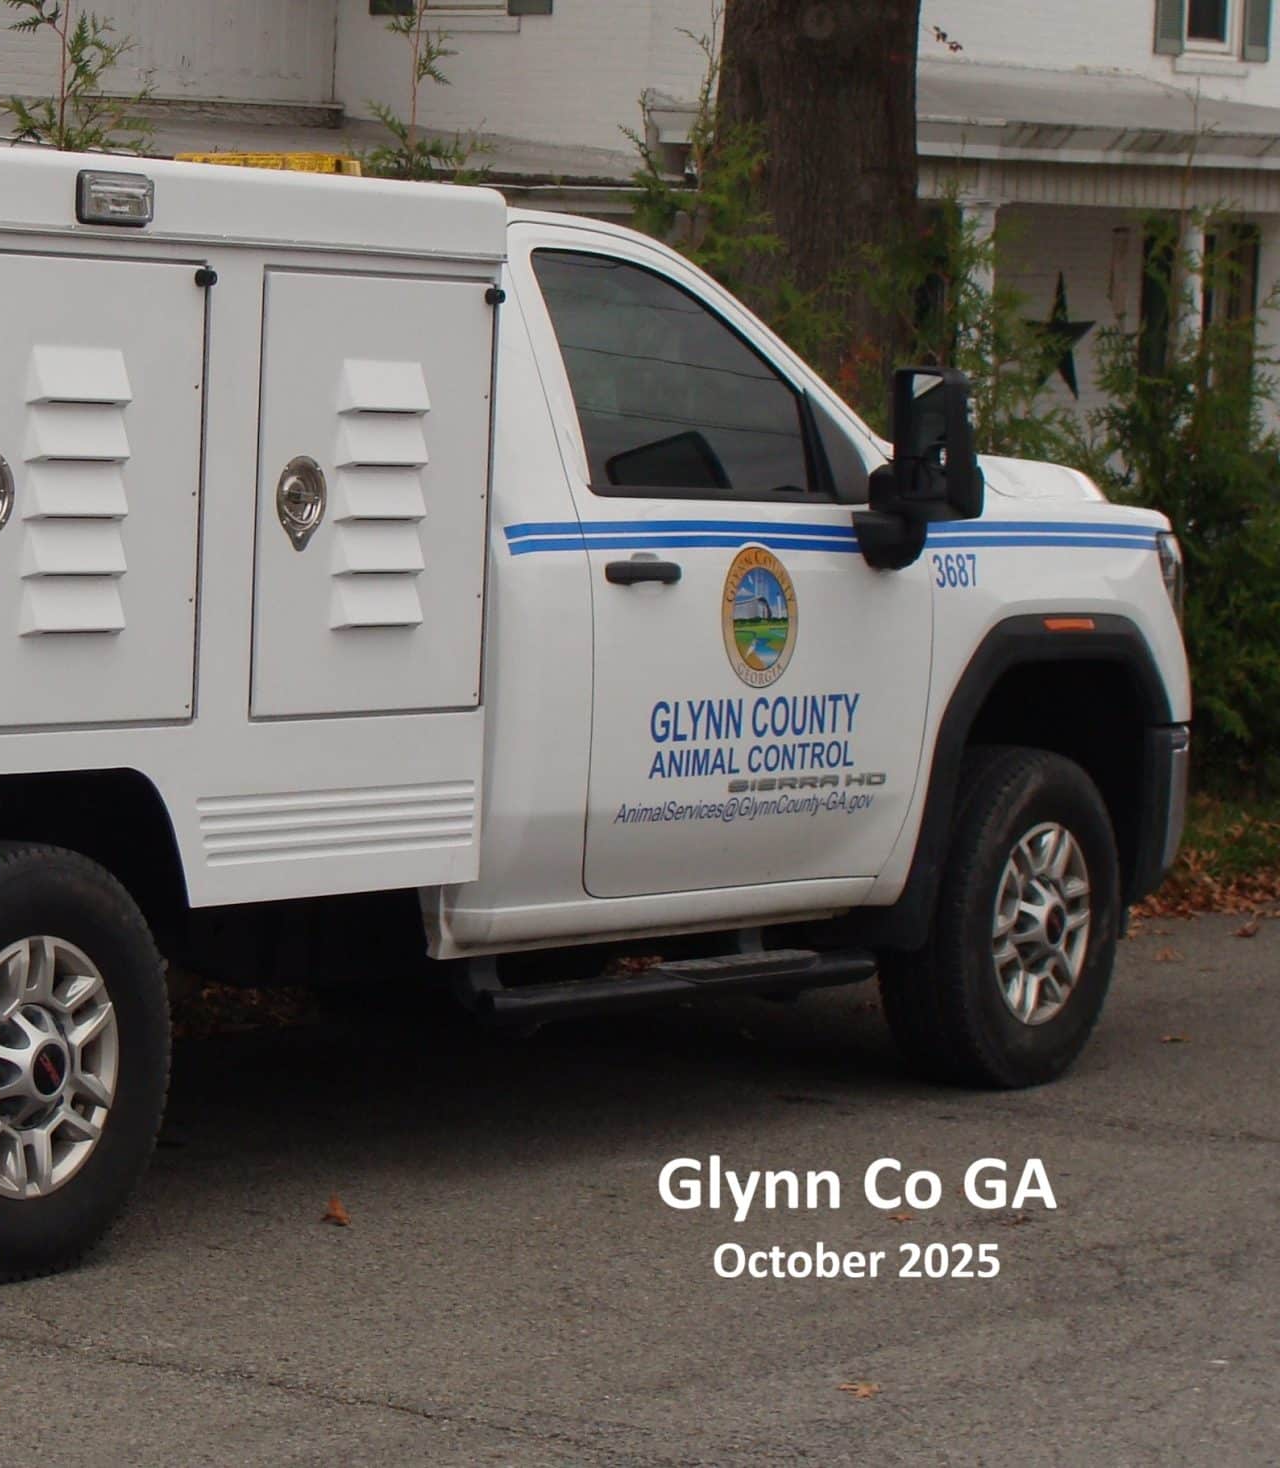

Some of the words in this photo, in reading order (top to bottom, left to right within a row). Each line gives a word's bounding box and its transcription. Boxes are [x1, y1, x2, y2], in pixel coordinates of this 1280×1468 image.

[932, 553, 977, 588] 3687
[736, 661, 783, 686] GEORGIA
[650, 697, 744, 744] GLYNN
[751, 692, 861, 739] COUNTY
[648, 746, 741, 780] ANIMAL
[747, 740, 855, 773] CONTROL
[727, 774, 840, 794] SIERRA
[845, 771, 887, 788] HD
[613, 791, 874, 826] AnimalServices@GlynnCounty-GA.gov
